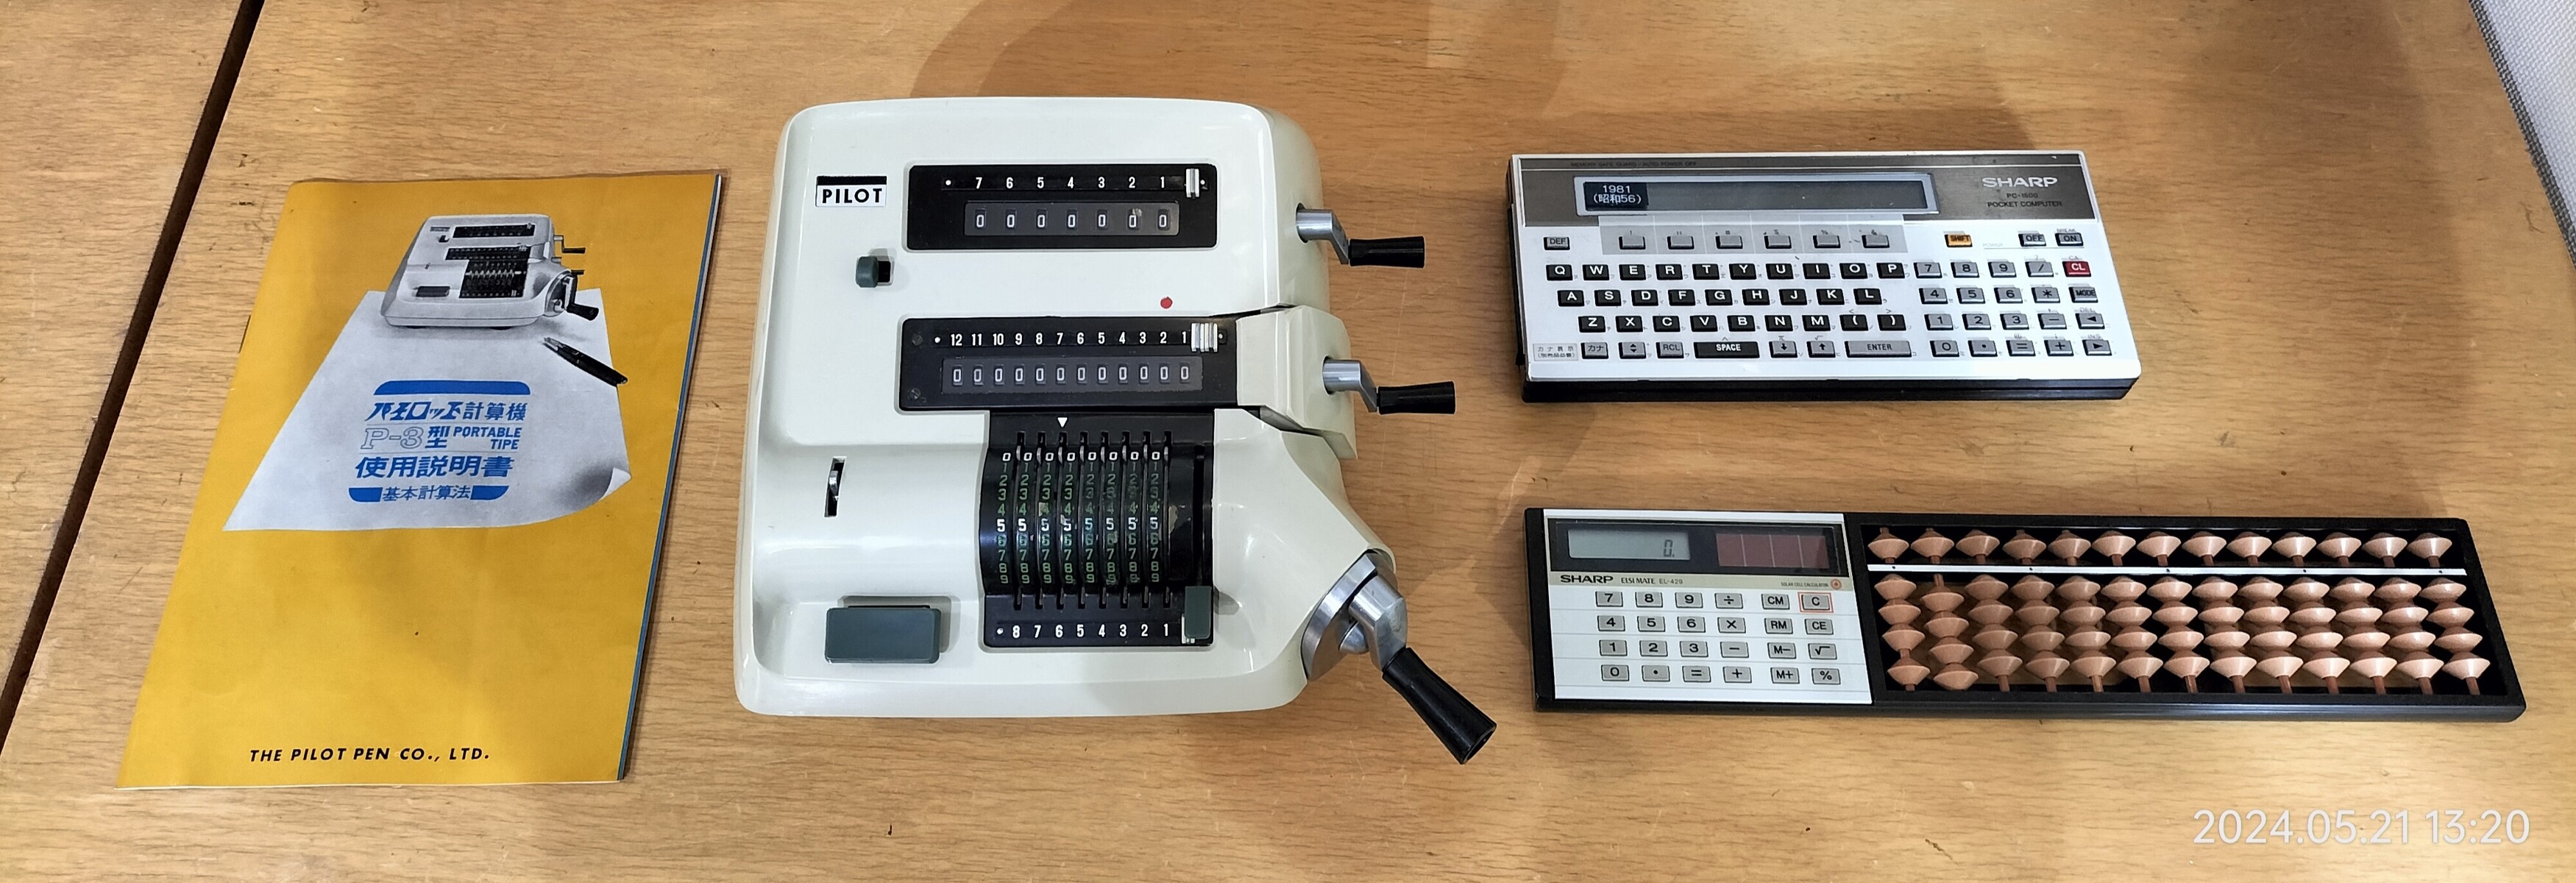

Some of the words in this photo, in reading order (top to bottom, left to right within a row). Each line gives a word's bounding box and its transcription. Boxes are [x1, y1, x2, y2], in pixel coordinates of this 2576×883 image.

[976, 177, 982, 189] 7
[1006, 177, 1013, 189] 6
[1037, 177, 1044, 188] 5
[1067, 176, 1074, 189] 4
[1098, 177, 1105, 188] 3
[1129, 176, 1135, 188] 2
[1160, 176, 1165, 188] 1
[1981, 177, 2058, 188] SHARP
[1603, 185, 1631, 194] 1981
[822, 188, 882, 204] PILOT
[1593, 194, 1642, 205] (昭和56)
[976, 214, 984, 227] 0
[1007, 214, 1015, 228] 0
[1037, 214, 1046, 228] 0
[1068, 214, 1076, 227] 0
[1098, 214, 1106, 227] 0
[1127, 213, 1138, 229] 0
[1159, 214, 1167, 227] 0
[1549, 237, 1566, 246] DEF
[2025, 234, 2044, 242] OFF
[1555, 266, 1566, 275] Q
[1589, 266, 1603, 274] W
[1629, 266, 1639, 274] E
[1665, 265, 1675, 274] R
[1702, 264, 1711, 274] T
[1739, 264, 1748, 273] Y
[1775, 264, 1786, 274] U
[1815, 264, 1820, 274] I
[1849, 263, 1861, 273] O
[1887, 263, 1897, 273] P
[1924, 263, 1932, 272] 7
[1962, 263, 1971, 273] 8
[1998, 263, 2008, 272] 9
[2071, 263, 2086, 271] CL
[1567, 291, 1578, 300] A
[1604, 291, 1614, 300] S
[1641, 291, 1651, 300] D
[1678, 291, 1686, 299] F
[1714, 291, 1725, 300] G
[1752, 290, 1762, 299] H
[1790, 290, 1798, 299] J
[1826, 289, 1837, 299] K
[1864, 289, 1874, 298] L
[1930, 289, 1940, 298] 4
[1968, 289, 1977, 299] 5
[2006, 289, 2015, 299] 6
[2075, 289, 2096, 297] MODE
[1588, 317, 1598, 327] Z
[1625, 317, 1636, 326] X
[1662, 317, 1672, 326] C
[1699, 316, 1709, 326] V
[1737, 316, 1748, 325] B
[1774, 316, 1786, 325] N
[1811, 316, 1824, 325] M
[1937, 316, 1943, 325] 1
[1974, 316, 1984, 325] 2
[2012, 315, 2021, 325] 3
[951, 333, 962, 347] 12
[971, 333, 982, 346] 11
[993, 333, 1004, 346] 10
[1015, 333, 1023, 345] 9
[1035, 333, 1043, 345] 8
[1057, 332, 1063, 345] 7
[1077, 332, 1085, 344] 6
[1098, 332, 1105, 344] 5
[1118, 331, 1126, 344] 4
[1139, 331, 1146, 344] 3
[1160, 331, 1167, 344] 2
[1182, 331, 1186, 344] 1
[1661, 344, 1681, 352] RCL
[1867, 343, 1892, 352] ENTER
[1942, 342, 1951, 351] 0
[953, 369, 962, 383] 0
[973, 369, 982, 383] 0
[995, 368, 1003, 382] 0
[1015, 368, 1023, 382] 0
[1036, 368, 1044, 382] 0
[1057, 367, 1065, 381] 0
[1077, 367, 1086, 381] 0
[1098, 366, 1107, 380] 0
[1118, 366, 1127, 380] 0
[1140, 366, 1148, 380] 0
[1160, 366, 1168, 380] 0
[1180, 366, 1189, 380] 0
[453, 426, 523, 439] PORTABLE
[490, 439, 519, 450] TIPE
[355, 455, 516, 479] 使用説明書
[382, 484, 472, 502] 基本計算法
[1560, 574, 1614, 584] SHARP
[1604, 593, 1614, 603] 7
[1644, 593, 1654, 603] 8
[1684, 595, 1694, 604] 9
[1767, 596, 1784, 605] CM
[1812, 596, 1820, 606] C
[1605, 617, 1617, 627] 4
[1647, 617, 1656, 628] 5
[1686, 618, 1697, 628] 6
[1770, 620, 1787, 629] RM
[1812, 621, 1827, 630] CE
[1012, 625, 1021, 639] 8
[1034, 625, 1041, 638] 7
[1055, 624, 1063, 638] 6
[1076, 624, 1085, 637] 5
[1098, 624, 1106, 637] 4
[1119, 624, 1126, 637] 3
[1141, 623, 1149, 636] 2
[1163, 623, 1168, 636] 1
[1609, 642, 1616, 652] 1
[1648, 642, 1658, 653] 2
[1689, 643, 1699, 653] 3
[1776, 670, 1794, 679] M+
[1820, 670, 1833, 681] %
[250, 749, 283, 762] THE
[291, 748, 347, 761] PILOT
[353, 748, 390, 760] PEN
[400, 748, 440, 762] CO.,
[449, 748, 489, 760] LTD.
